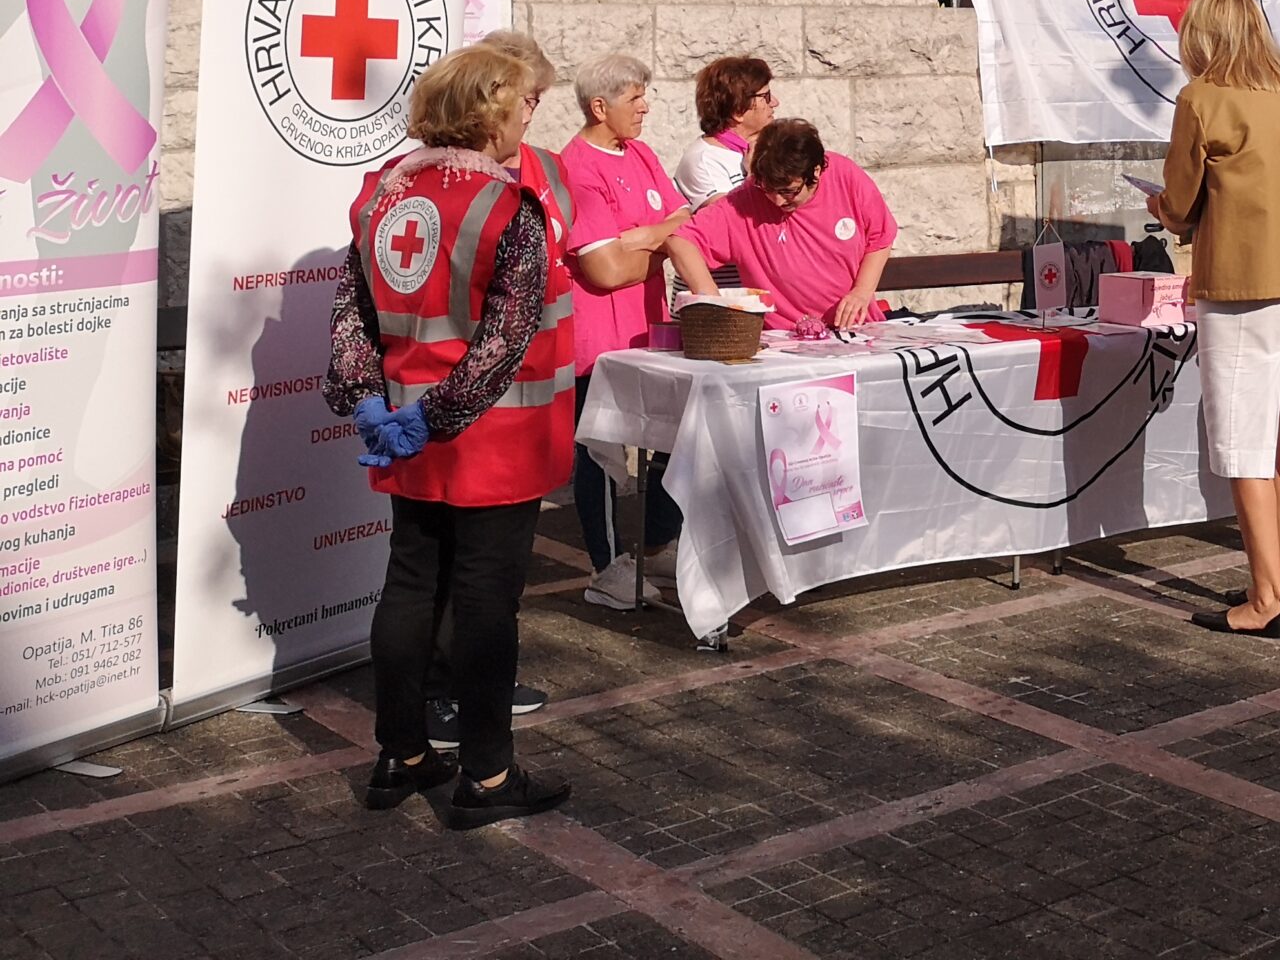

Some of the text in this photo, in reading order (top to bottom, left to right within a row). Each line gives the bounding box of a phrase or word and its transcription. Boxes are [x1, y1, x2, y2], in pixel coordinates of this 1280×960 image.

[292, 101, 402, 140] GRADSKO DRUŠTVO
[280, 116, 333, 157] CRVENOG
[336, 141, 372, 158] KRIŽA
[0, 265, 64, 289] nosti:
[0, 296, 130, 322] anja sa stručnjacima
[9, 328, 23, 340] za
[27, 319, 73, 338] bolesti
[76, 316, 111, 333] dojke
[227, 375, 323, 405] NEOVISNOST
[18, 448, 63, 472] pomoć
[3, 474, 59, 501] pregledi
[12, 502, 65, 523] vodstvo
[69, 483, 151, 511] fizioterapeuta
[221, 486, 306, 519] JEDINSTVO
[24, 524, 76, 546] kuhanja
[313, 519, 392, 551] UNIVERZAL
[52, 561, 110, 584] društvene
[45, 598, 49, 612] i
[52, 585, 115, 609] udrugama
[255, 589, 383, 638] Pokretani humanošć
[22, 615, 143, 661] Opatija, M. Tita 86
[48, 632, 142, 670] Tel.: 051/ 712-577
[35, 648, 141, 690] Mob.: 091 9462 082
[35, 665, 141, 706] hck-opatija@inet.hr
